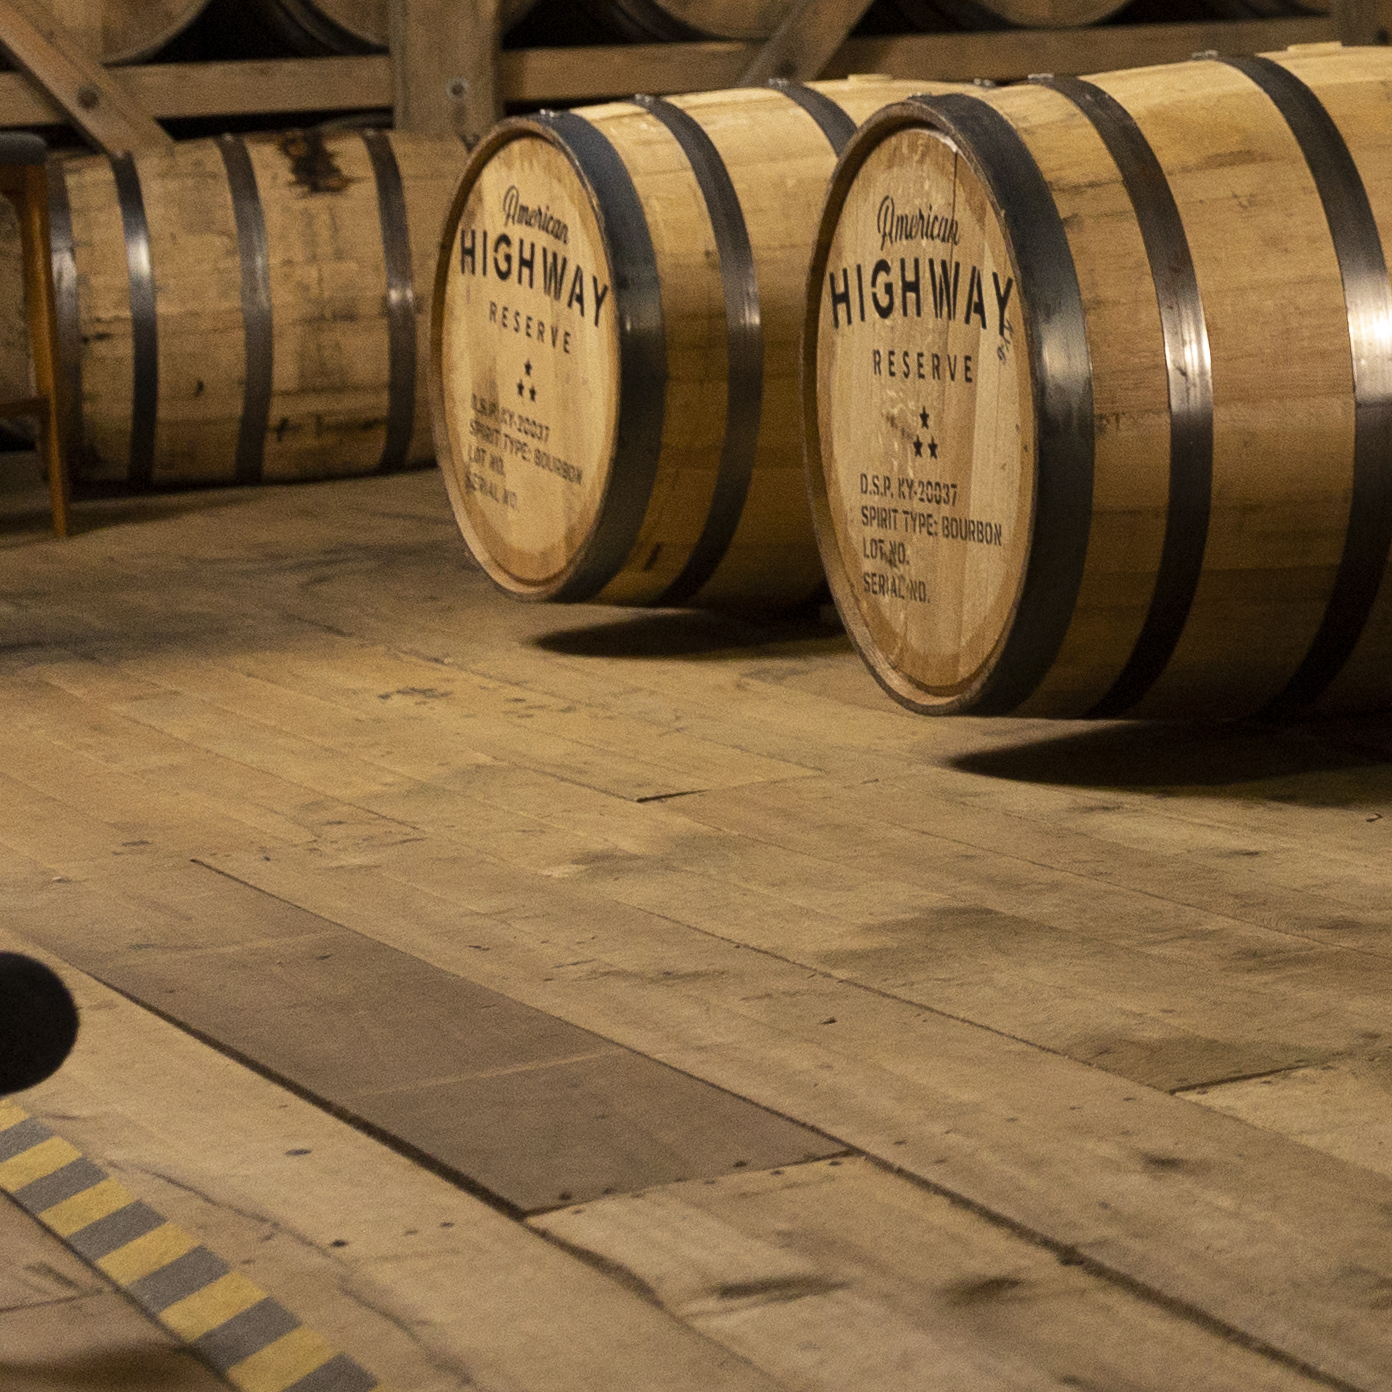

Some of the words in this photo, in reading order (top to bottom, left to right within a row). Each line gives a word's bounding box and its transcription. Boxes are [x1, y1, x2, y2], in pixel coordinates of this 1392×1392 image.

[503, 184, 569, 245] American
[877, 195, 960, 252] American
[460, 229, 609, 328] HIGHWAY
[829, 257, 1014, 338] HIGHWAY
[489, 300, 571, 355] RESERVE
[872, 349, 973, 384] RESERVE
[860, 472, 895, 499] D.S.P.
[897, 476, 958, 507] KY-20037
[860, 505, 899, 531] SPIRIT
[901, 510, 938, 536] TYPE:
[941, 516, 1002, 547] BOURBON
[862, 537, 886, 561] LOT
[863, 571, 905, 600] SERIAL
